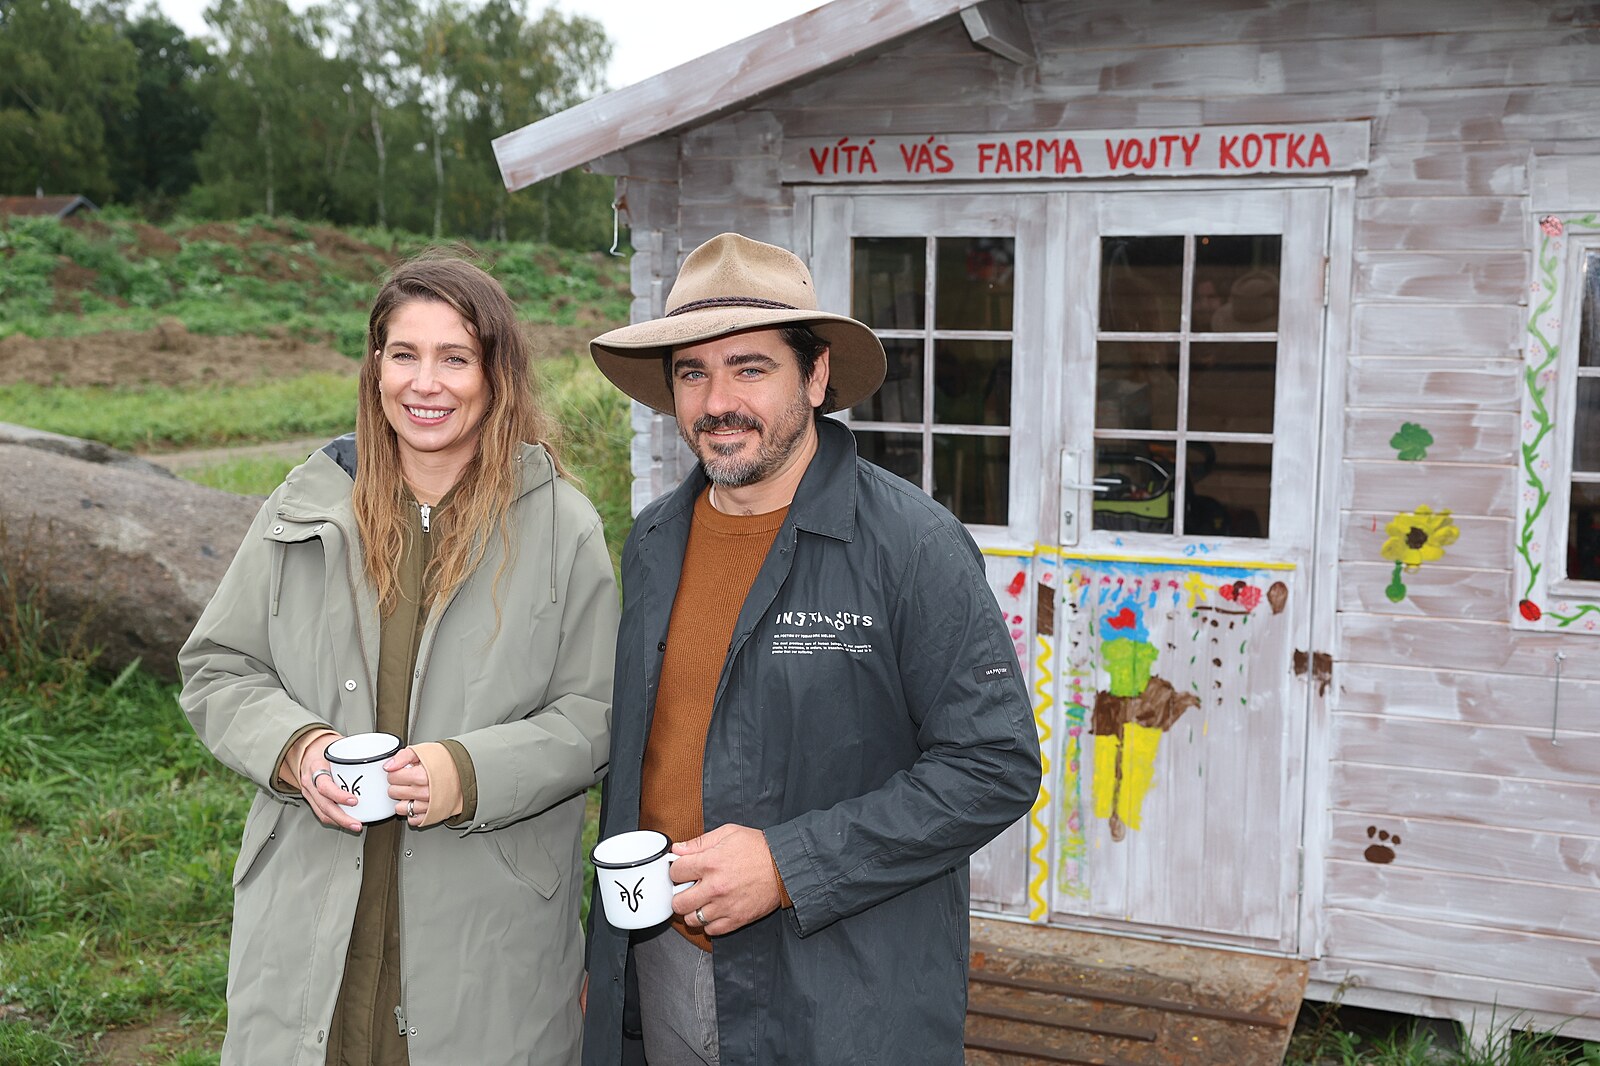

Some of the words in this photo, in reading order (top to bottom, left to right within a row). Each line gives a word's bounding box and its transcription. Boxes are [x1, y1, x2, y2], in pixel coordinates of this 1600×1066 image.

[809, 137, 877, 174] VÍTÁ
[900, 136, 955, 172] VÁS
[977, 139, 1083, 173] FARMA
[1105, 133, 1201, 170] VOJTY
[1219, 132, 1331, 169] KOTKA
